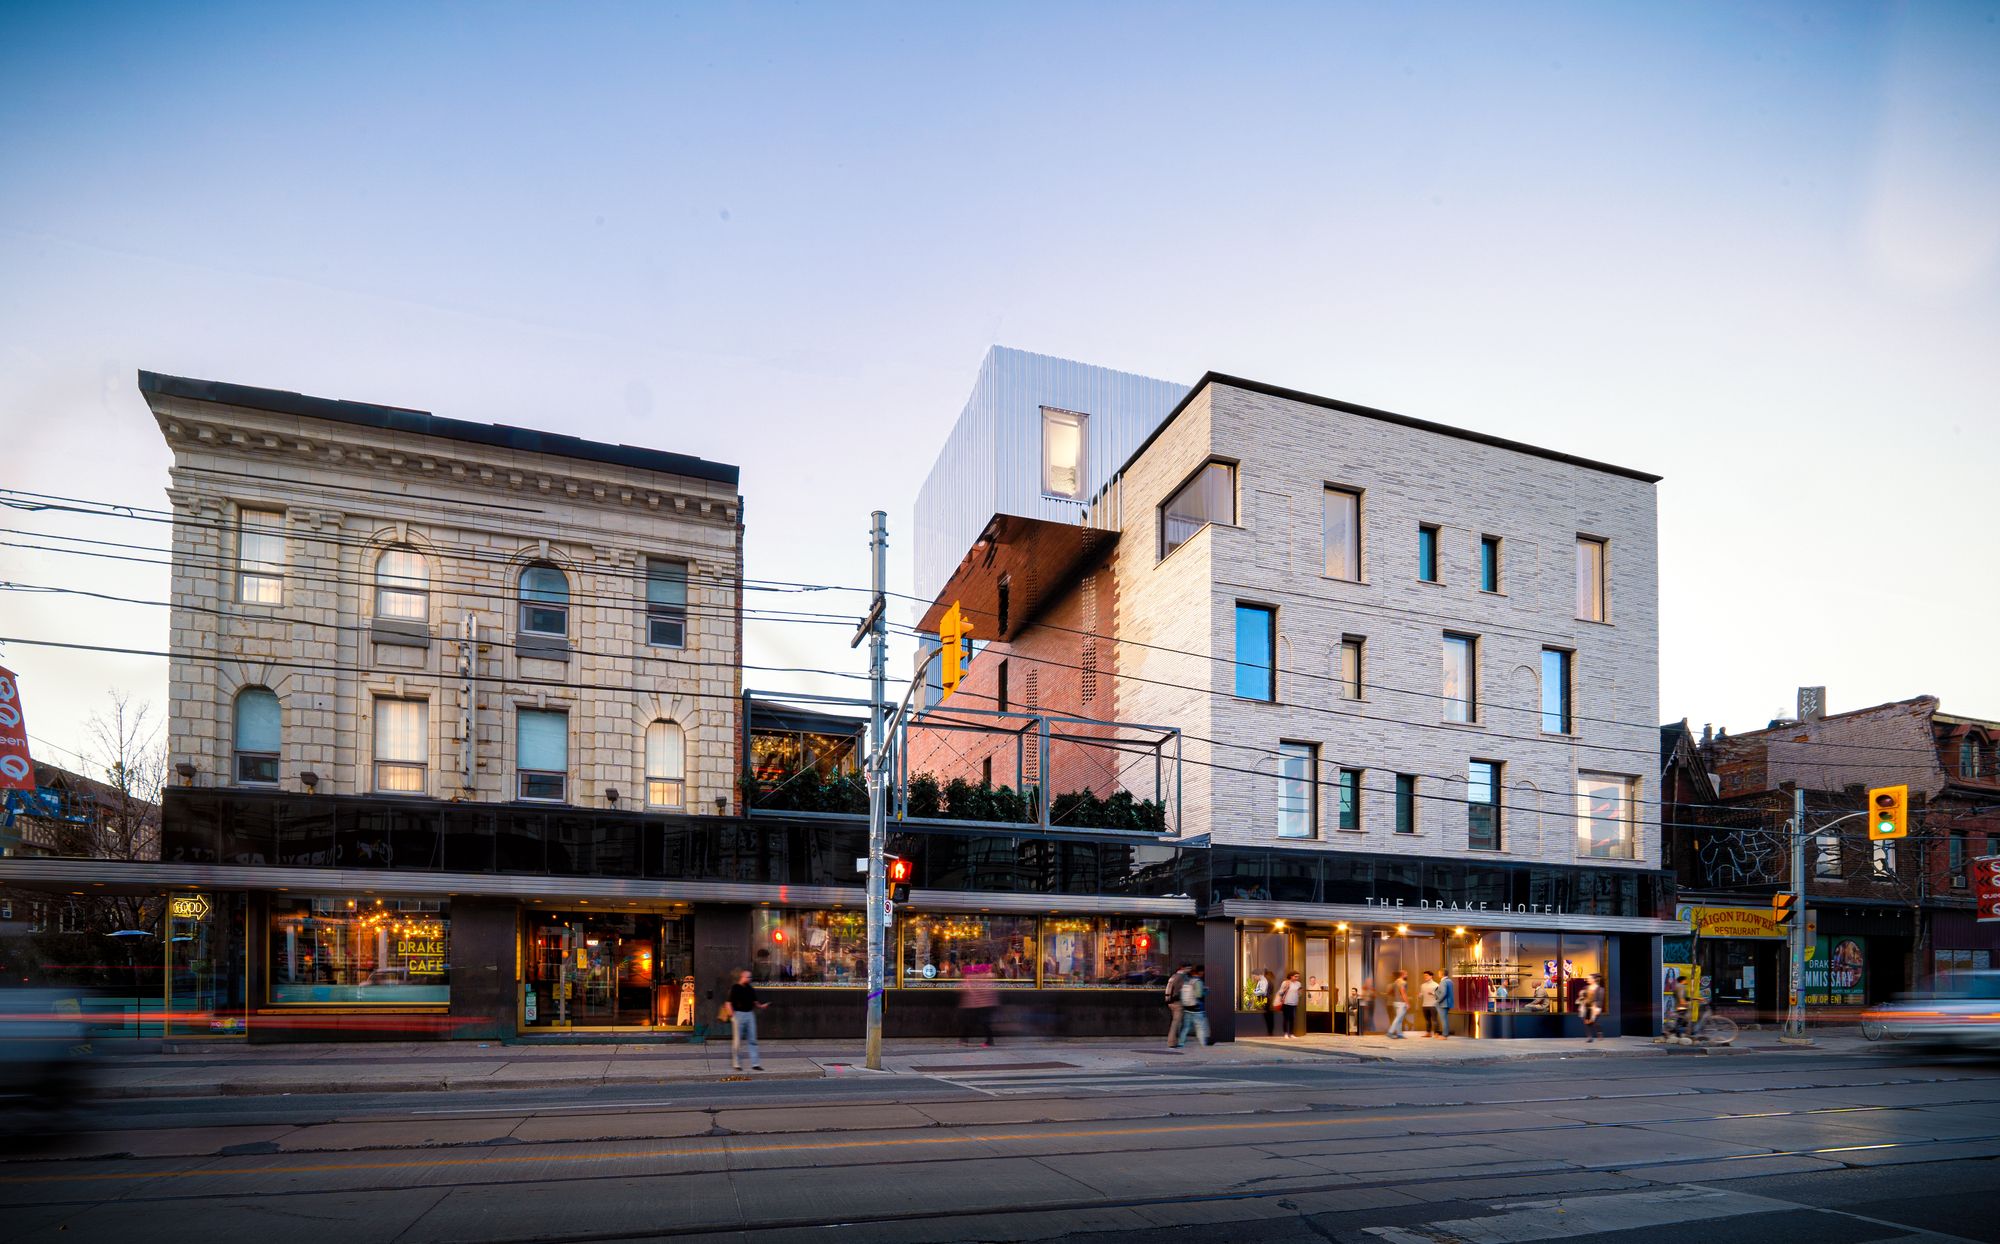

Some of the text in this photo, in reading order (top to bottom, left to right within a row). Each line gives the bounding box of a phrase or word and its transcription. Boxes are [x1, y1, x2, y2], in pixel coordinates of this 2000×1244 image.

[1366, 897, 1565, 916] THE DRAKE HOTEL
[1736, 911, 1775, 931] FLOWER
[1714, 926, 1761, 936] RESTAURANT
[398, 941, 445, 953] DRAKE
[409, 957, 445, 971] CAFÉ
[1809, 959, 1834, 969] DRAKE
